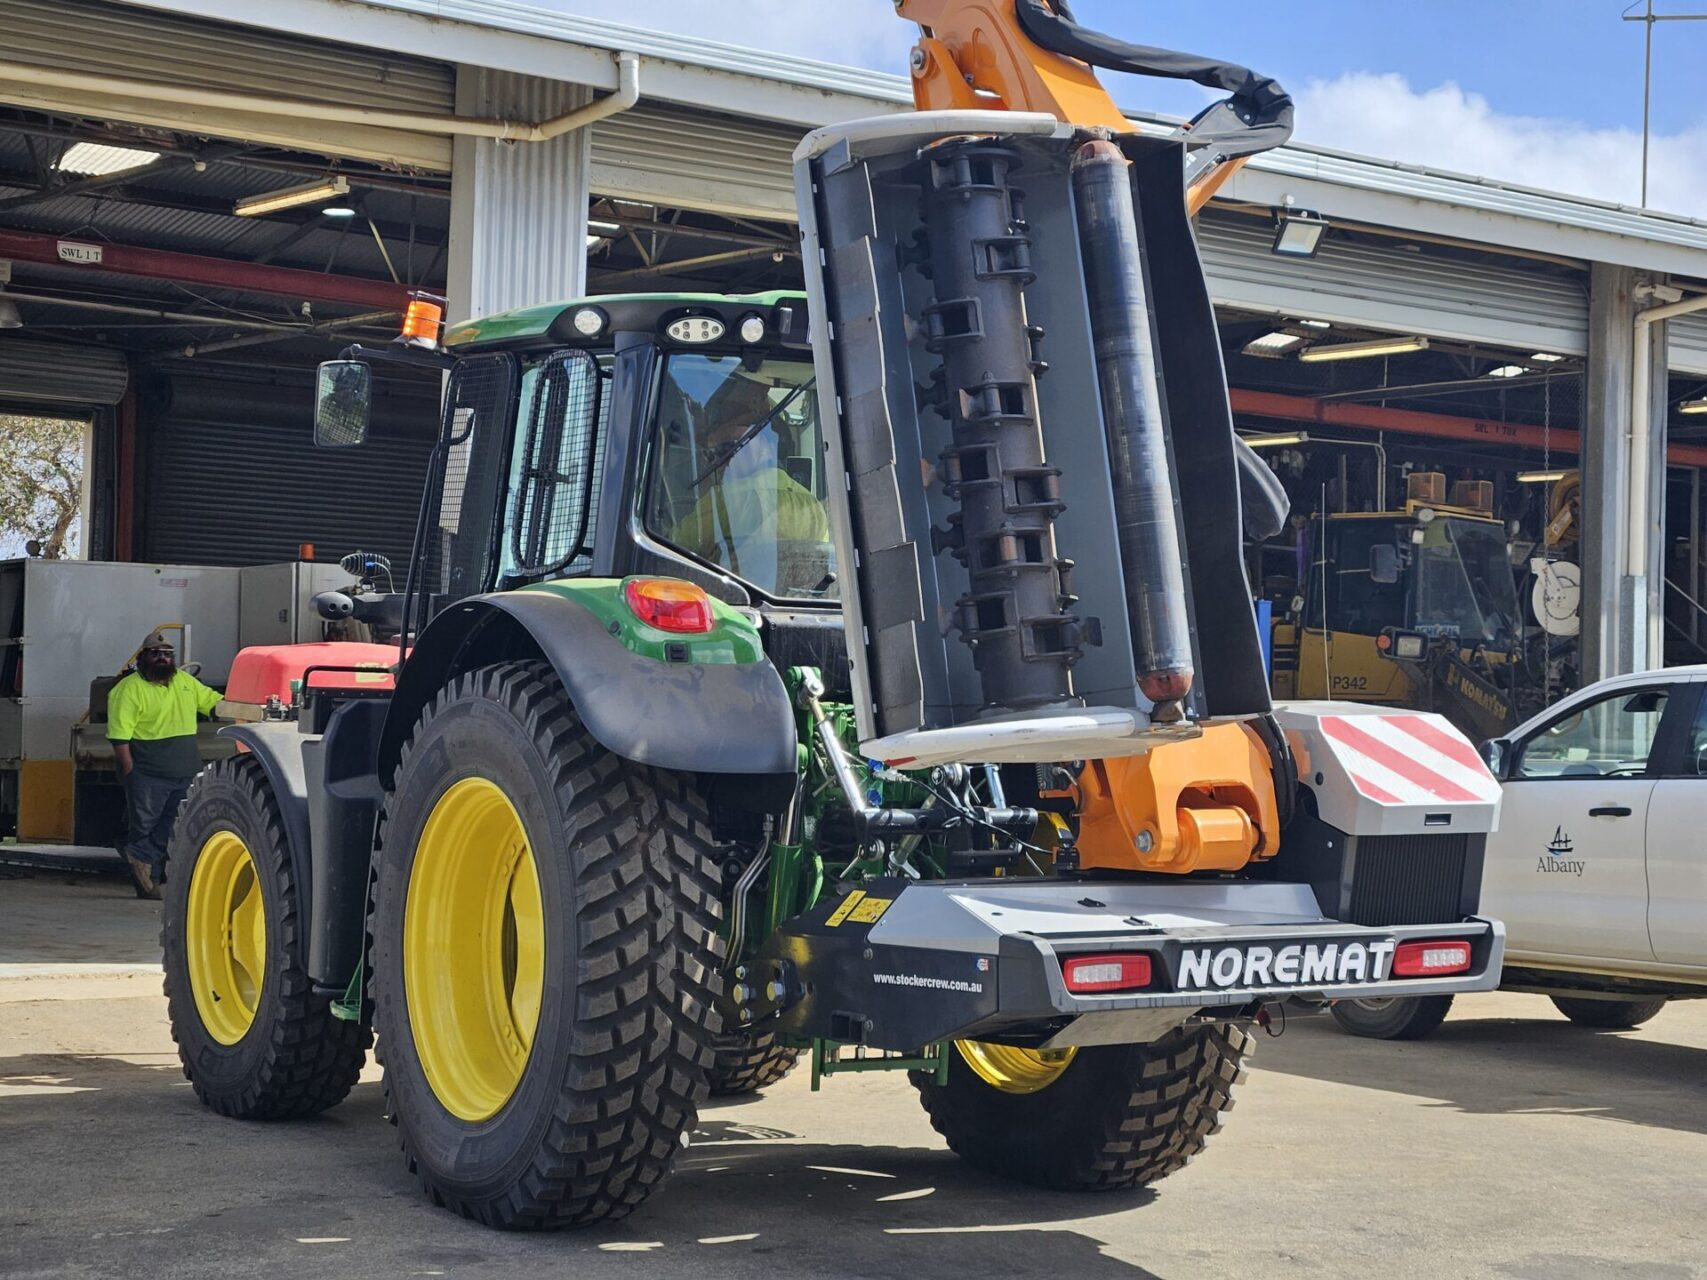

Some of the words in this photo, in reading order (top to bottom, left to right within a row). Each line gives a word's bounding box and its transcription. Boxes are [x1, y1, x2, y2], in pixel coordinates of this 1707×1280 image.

[61, 247, 82, 259] SWL
[94, 251, 100, 261] T
[1333, 676, 1367, 690] P342
[1460, 677, 1507, 720] KOMATSU
[1536, 856, 1585, 877] Albany
[1177, 941, 1394, 989] NOREMAT
[873, 973, 982, 993] www.stockercrew.com.au
